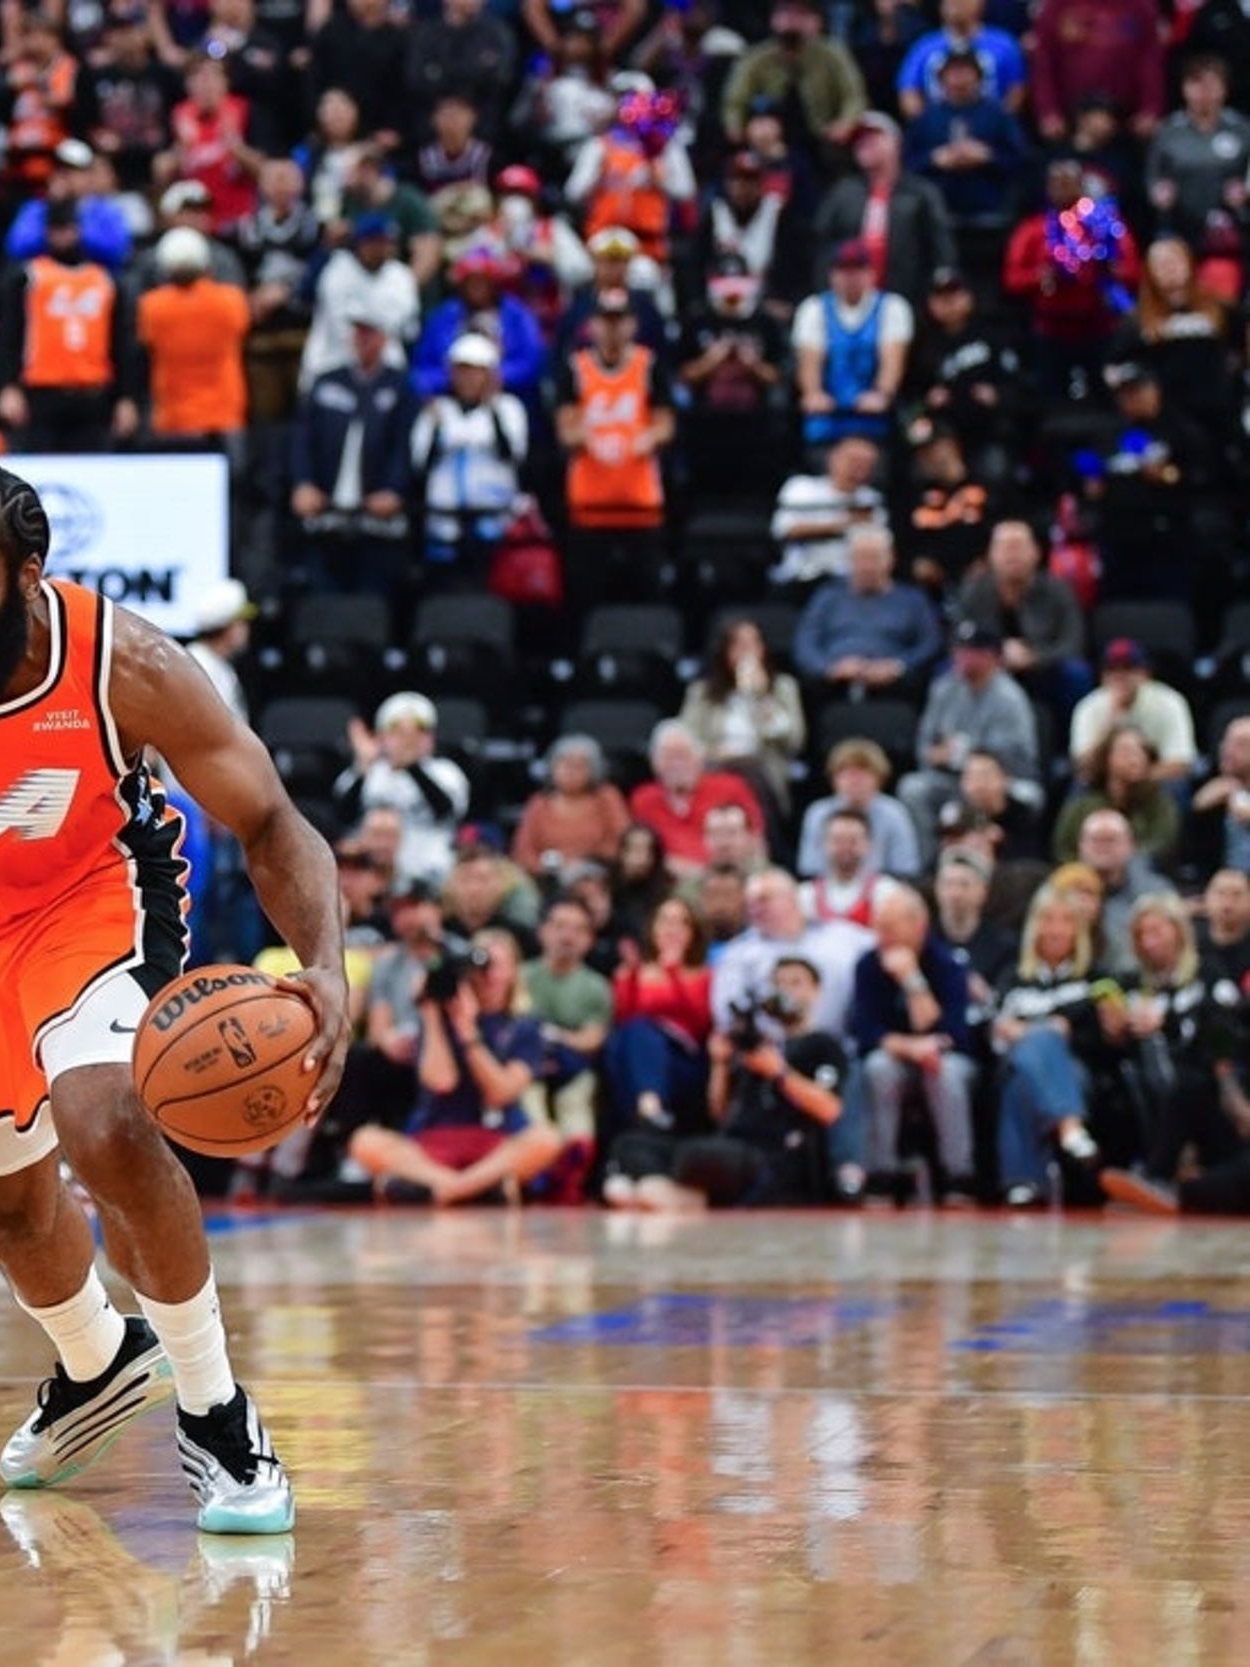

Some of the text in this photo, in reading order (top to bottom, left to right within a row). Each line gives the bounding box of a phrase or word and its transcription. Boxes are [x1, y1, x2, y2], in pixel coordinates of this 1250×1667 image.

[46, 708, 79, 721] VISIT
[32, 718, 91, 732] RWANDA
[152, 972, 271, 1033] Wilson
